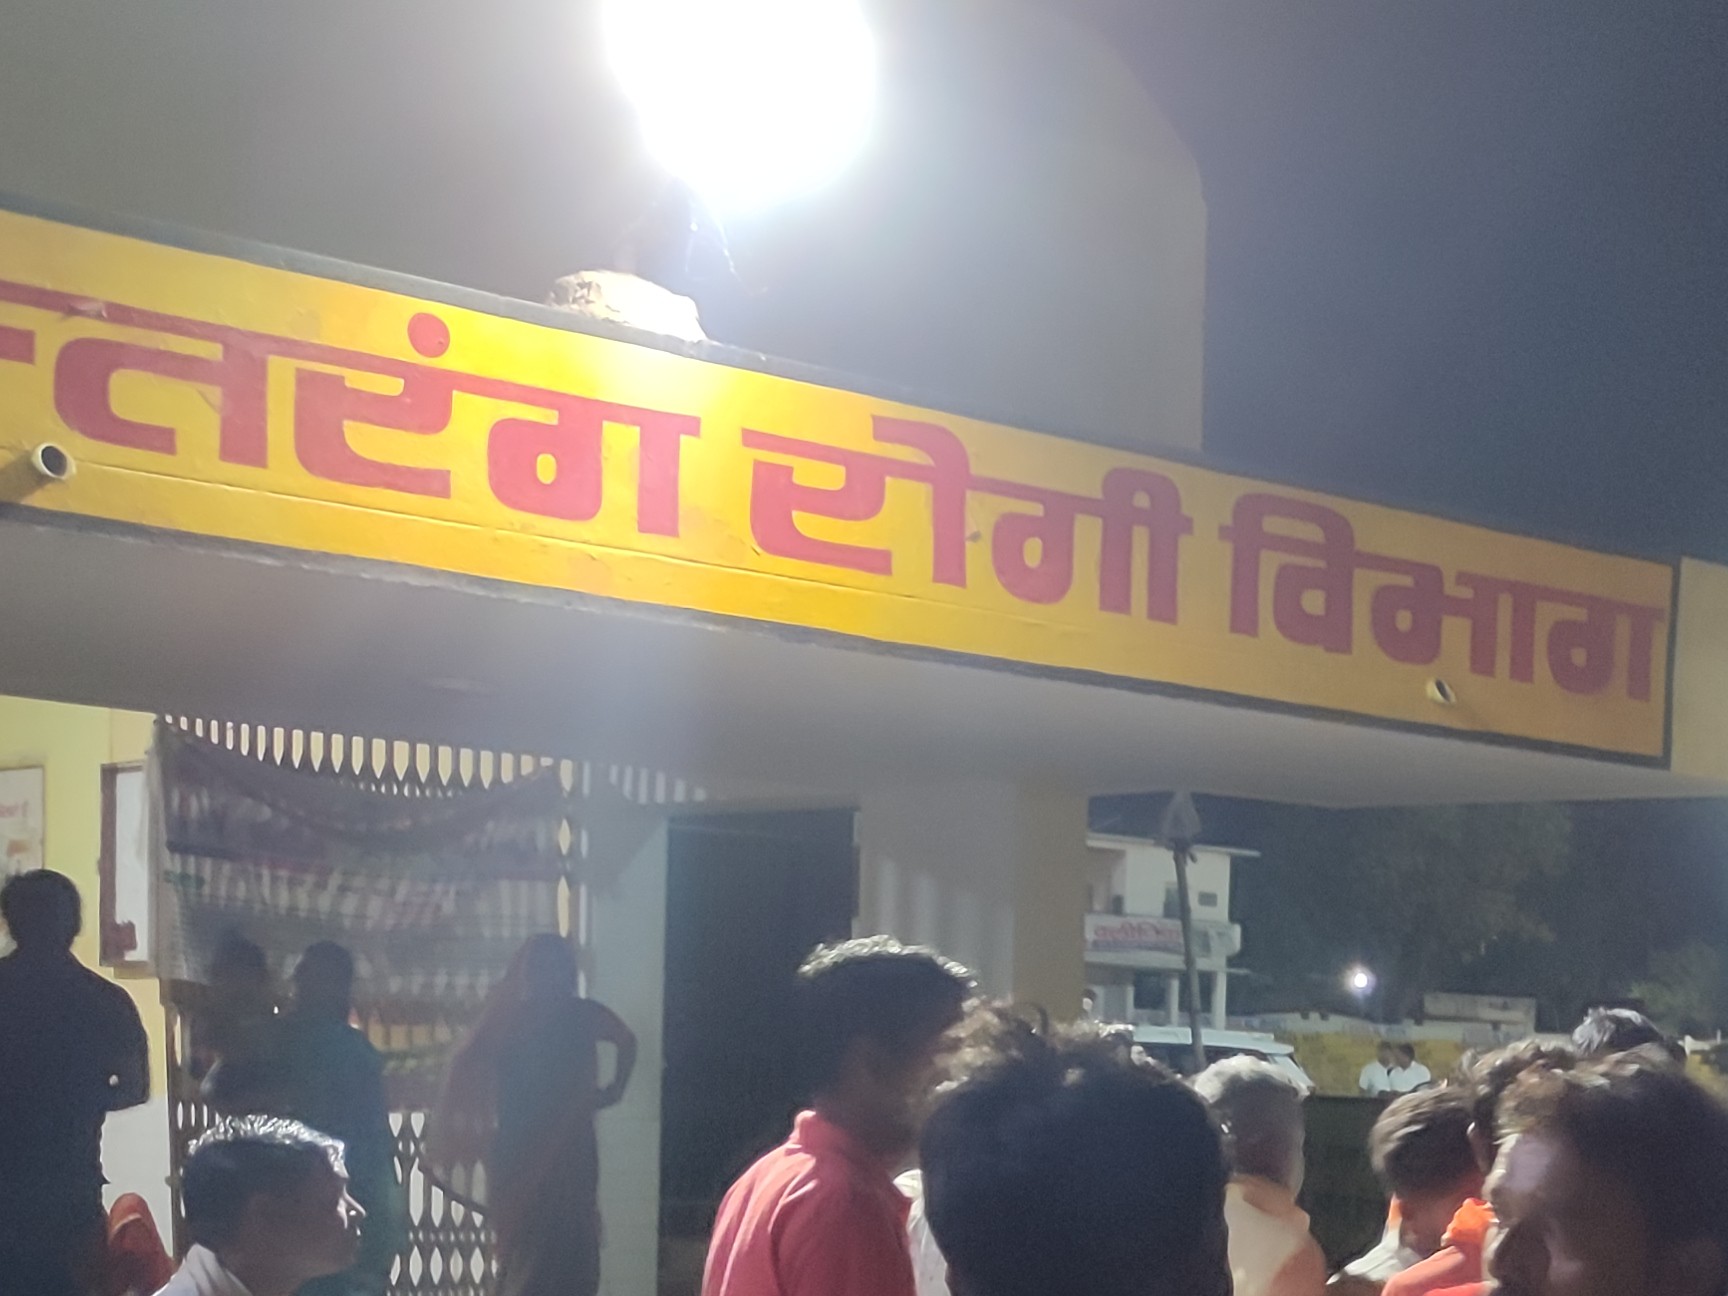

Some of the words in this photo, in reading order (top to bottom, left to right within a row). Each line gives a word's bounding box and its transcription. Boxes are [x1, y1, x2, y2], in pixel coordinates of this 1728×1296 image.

[0, 280, 701, 537] तरंग
[743, 414, 1193, 625] रोगी
[1218, 492, 1664, 702] विभाग
